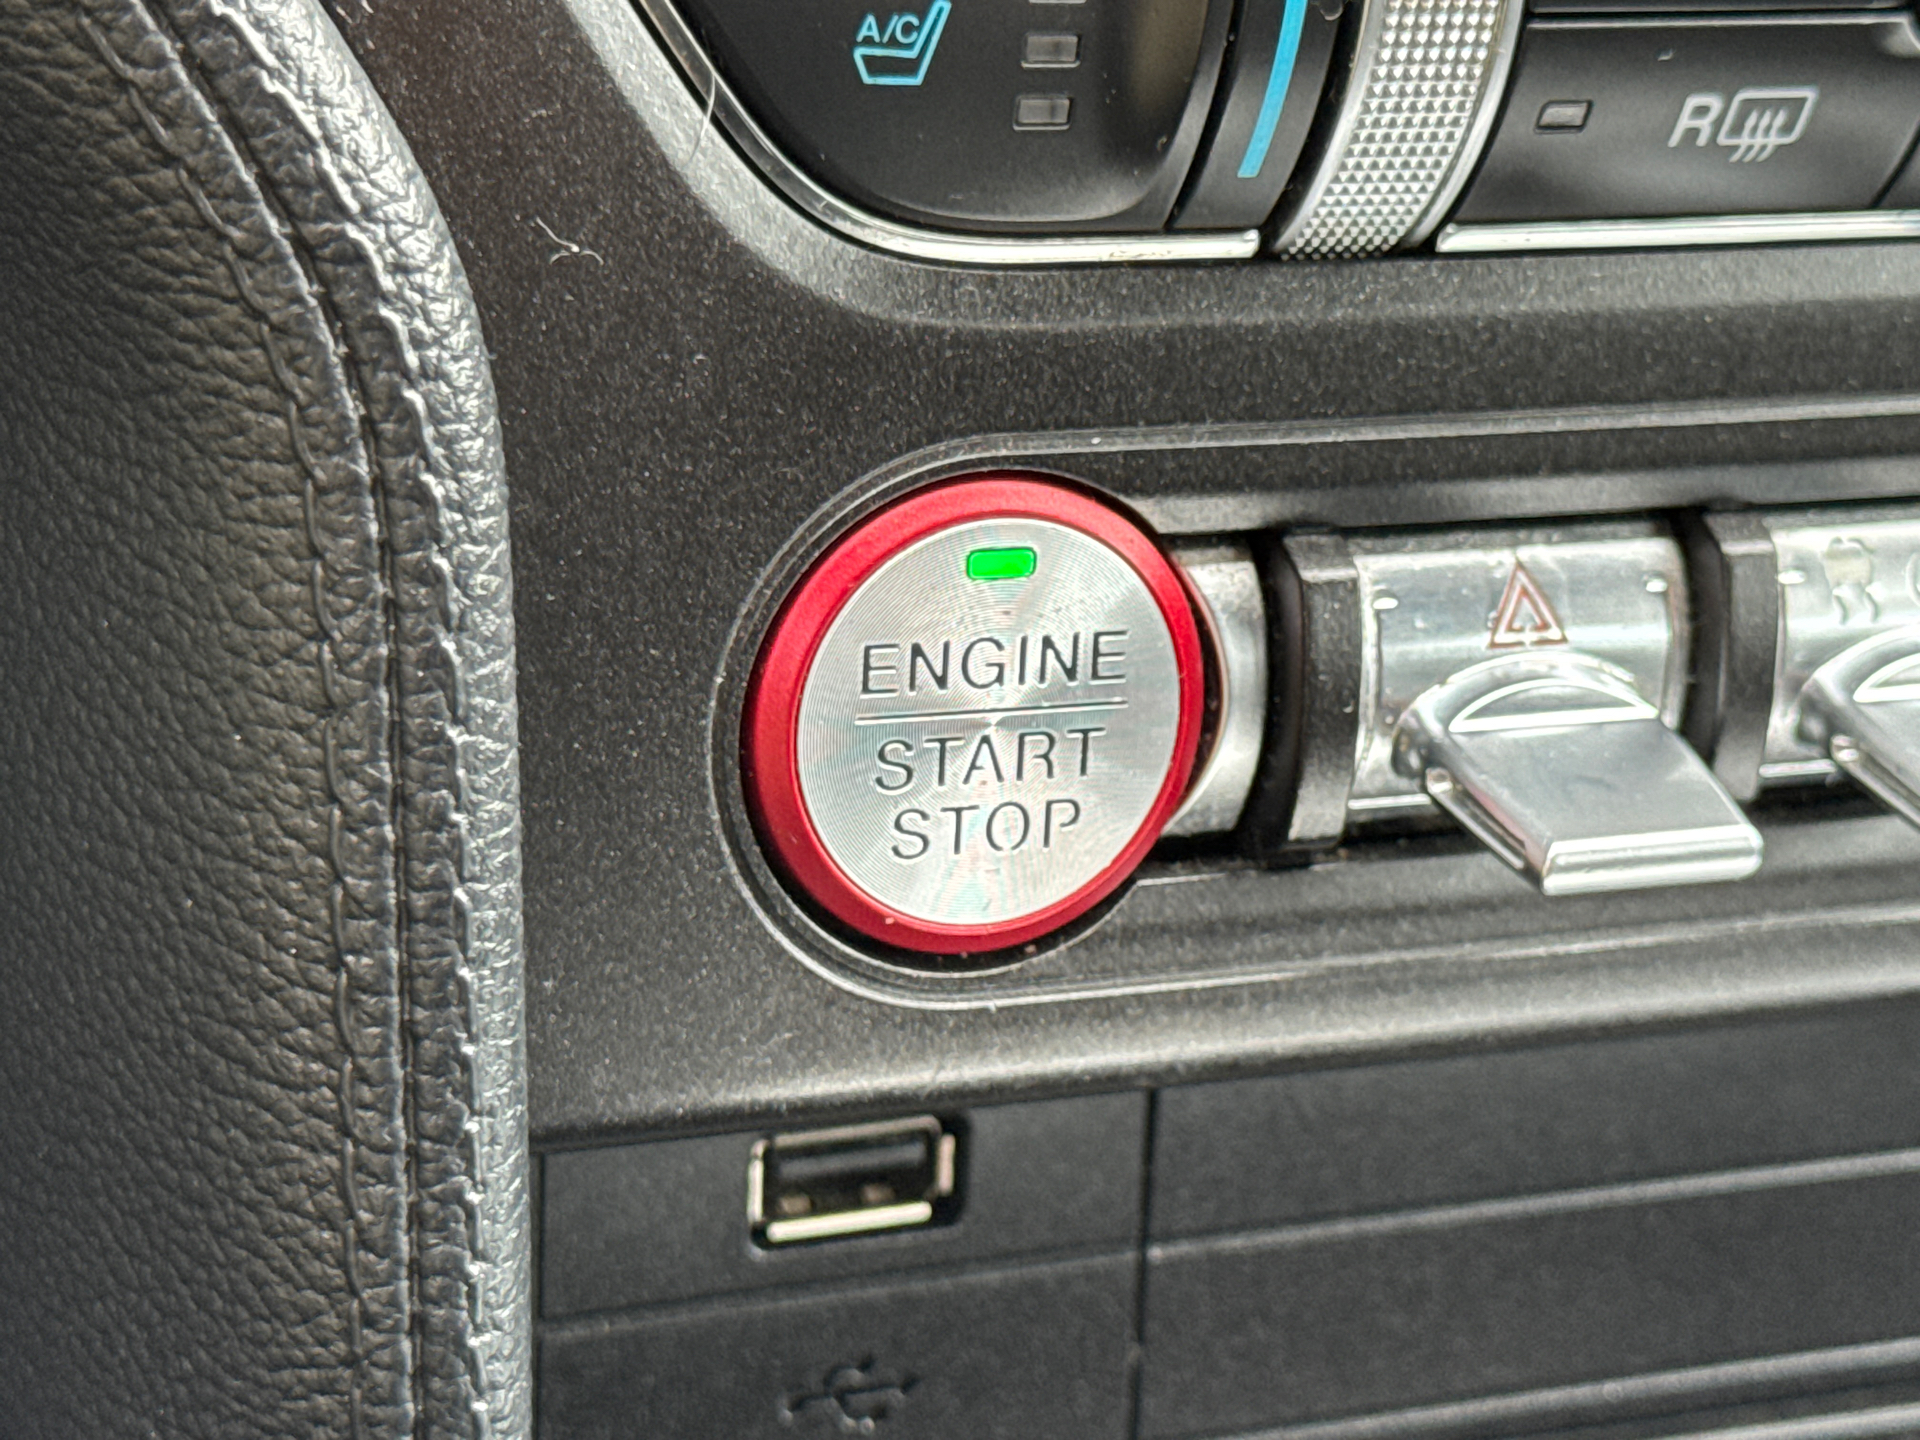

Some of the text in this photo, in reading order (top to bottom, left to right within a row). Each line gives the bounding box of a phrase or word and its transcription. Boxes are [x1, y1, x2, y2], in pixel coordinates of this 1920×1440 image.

[856, 14, 919, 44] A/C
[1668, 94, 1723, 147] R
[861, 629, 1129, 697] ENGINE
[874, 726, 1106, 794] START
[890, 798, 1081, 861] STOP
